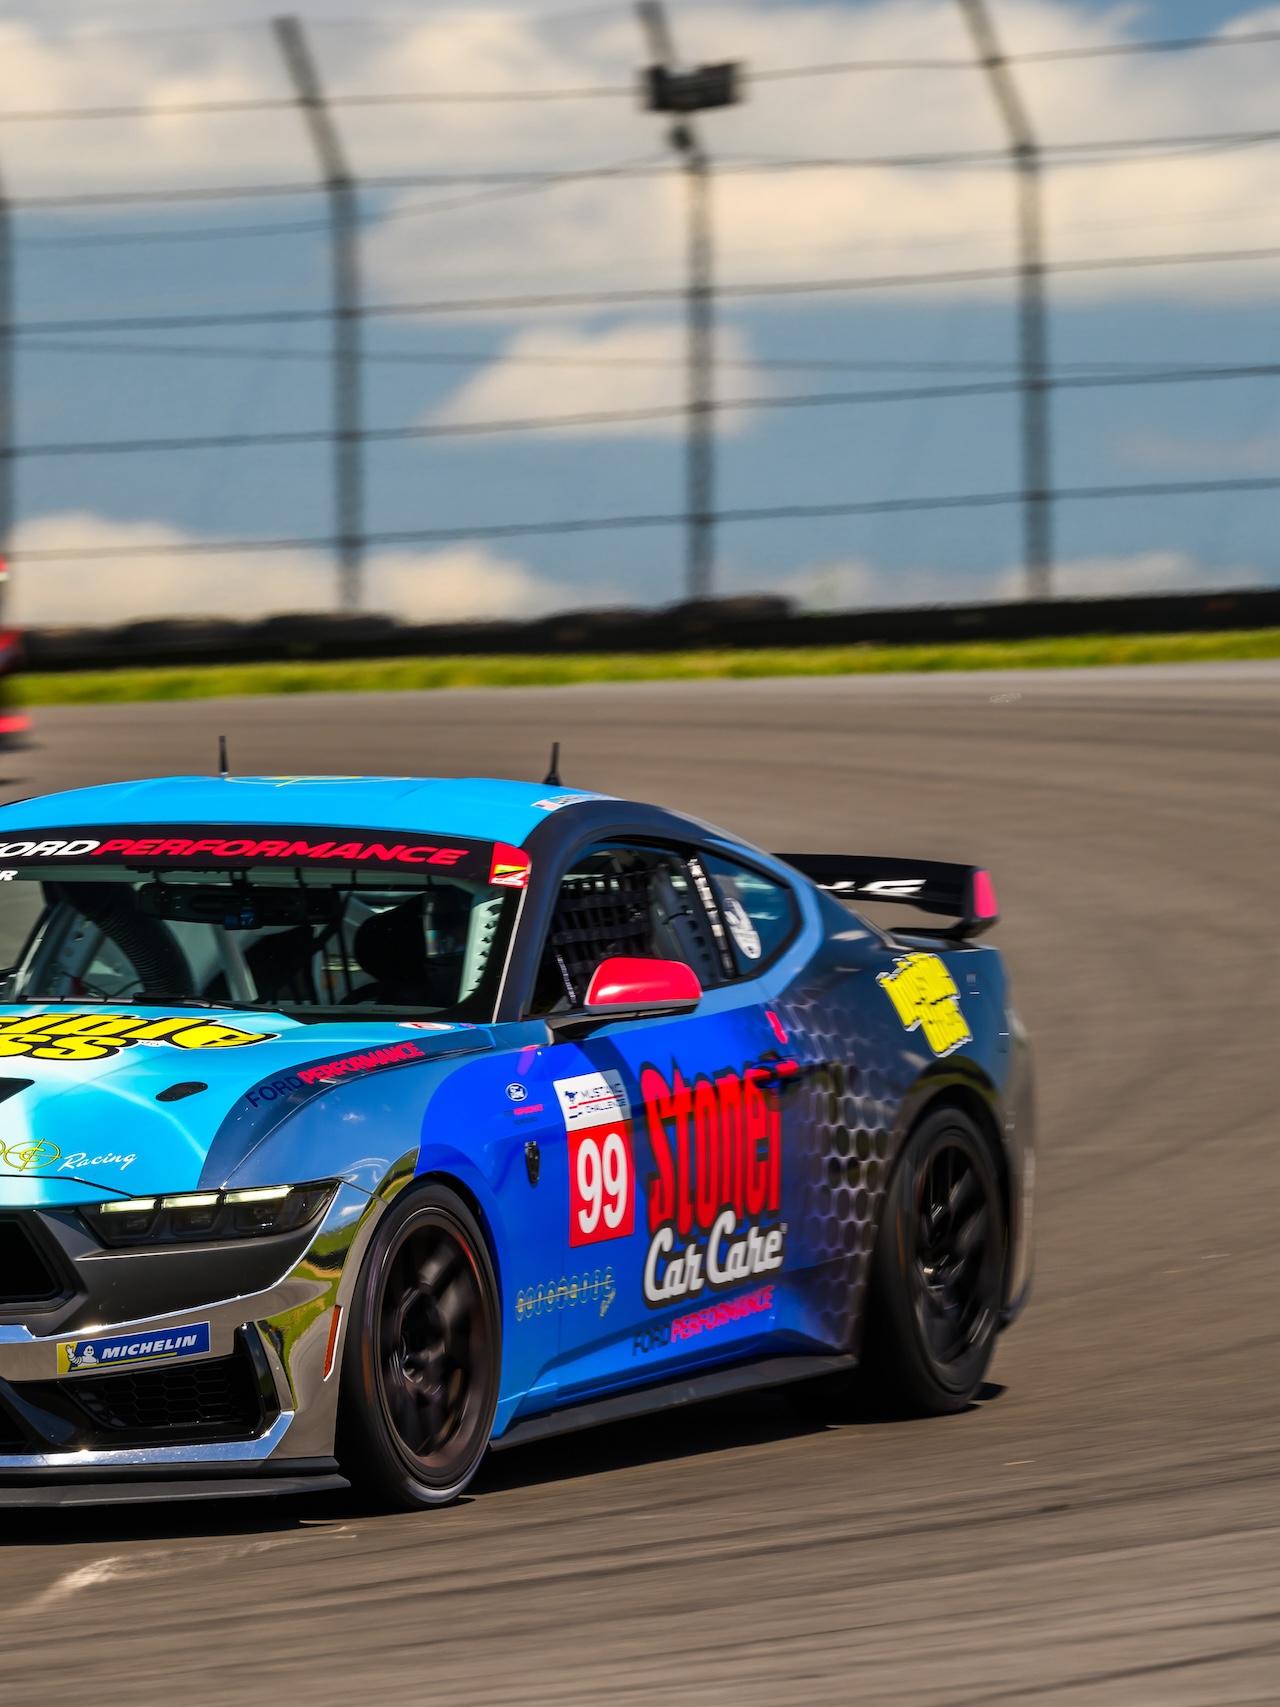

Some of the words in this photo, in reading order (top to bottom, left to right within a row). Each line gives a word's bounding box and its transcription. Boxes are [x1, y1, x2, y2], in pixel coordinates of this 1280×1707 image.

[56, 1151, 138, 1173] Racing
[576, 1133, 628, 1234] 99
[643, 1226, 705, 1302] Car
[706, 1209, 785, 1285] Care
[101, 1334, 198, 1360] MICHELIN
